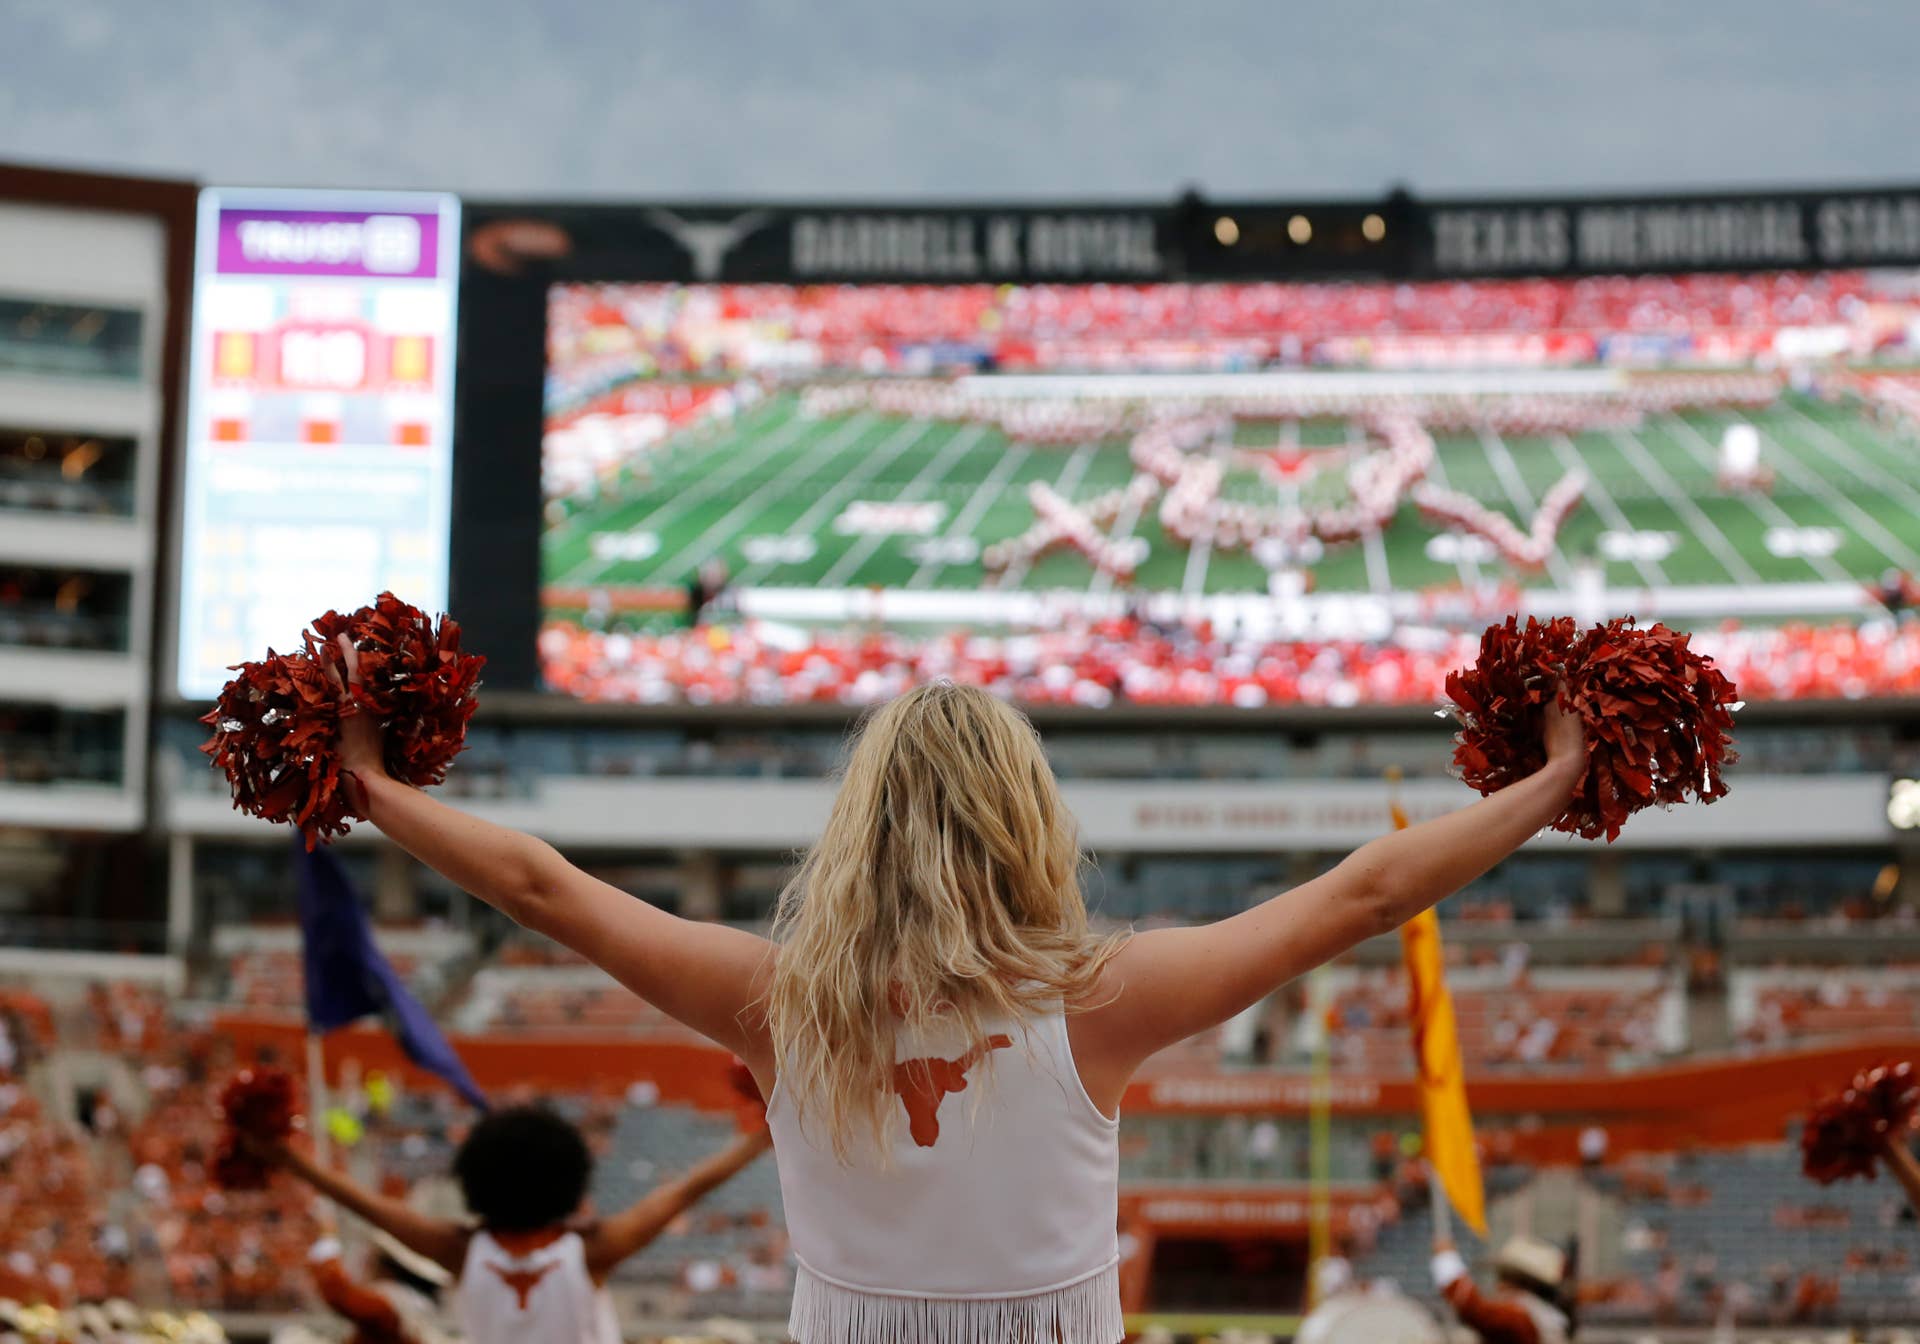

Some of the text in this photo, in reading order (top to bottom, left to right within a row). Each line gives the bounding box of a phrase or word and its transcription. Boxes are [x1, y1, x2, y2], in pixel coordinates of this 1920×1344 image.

[1028, 213, 1161, 273] ROYAL
[1433, 208, 1569, 271] TEXAS
[1575, 203, 1806, 266] MEMORIAL
